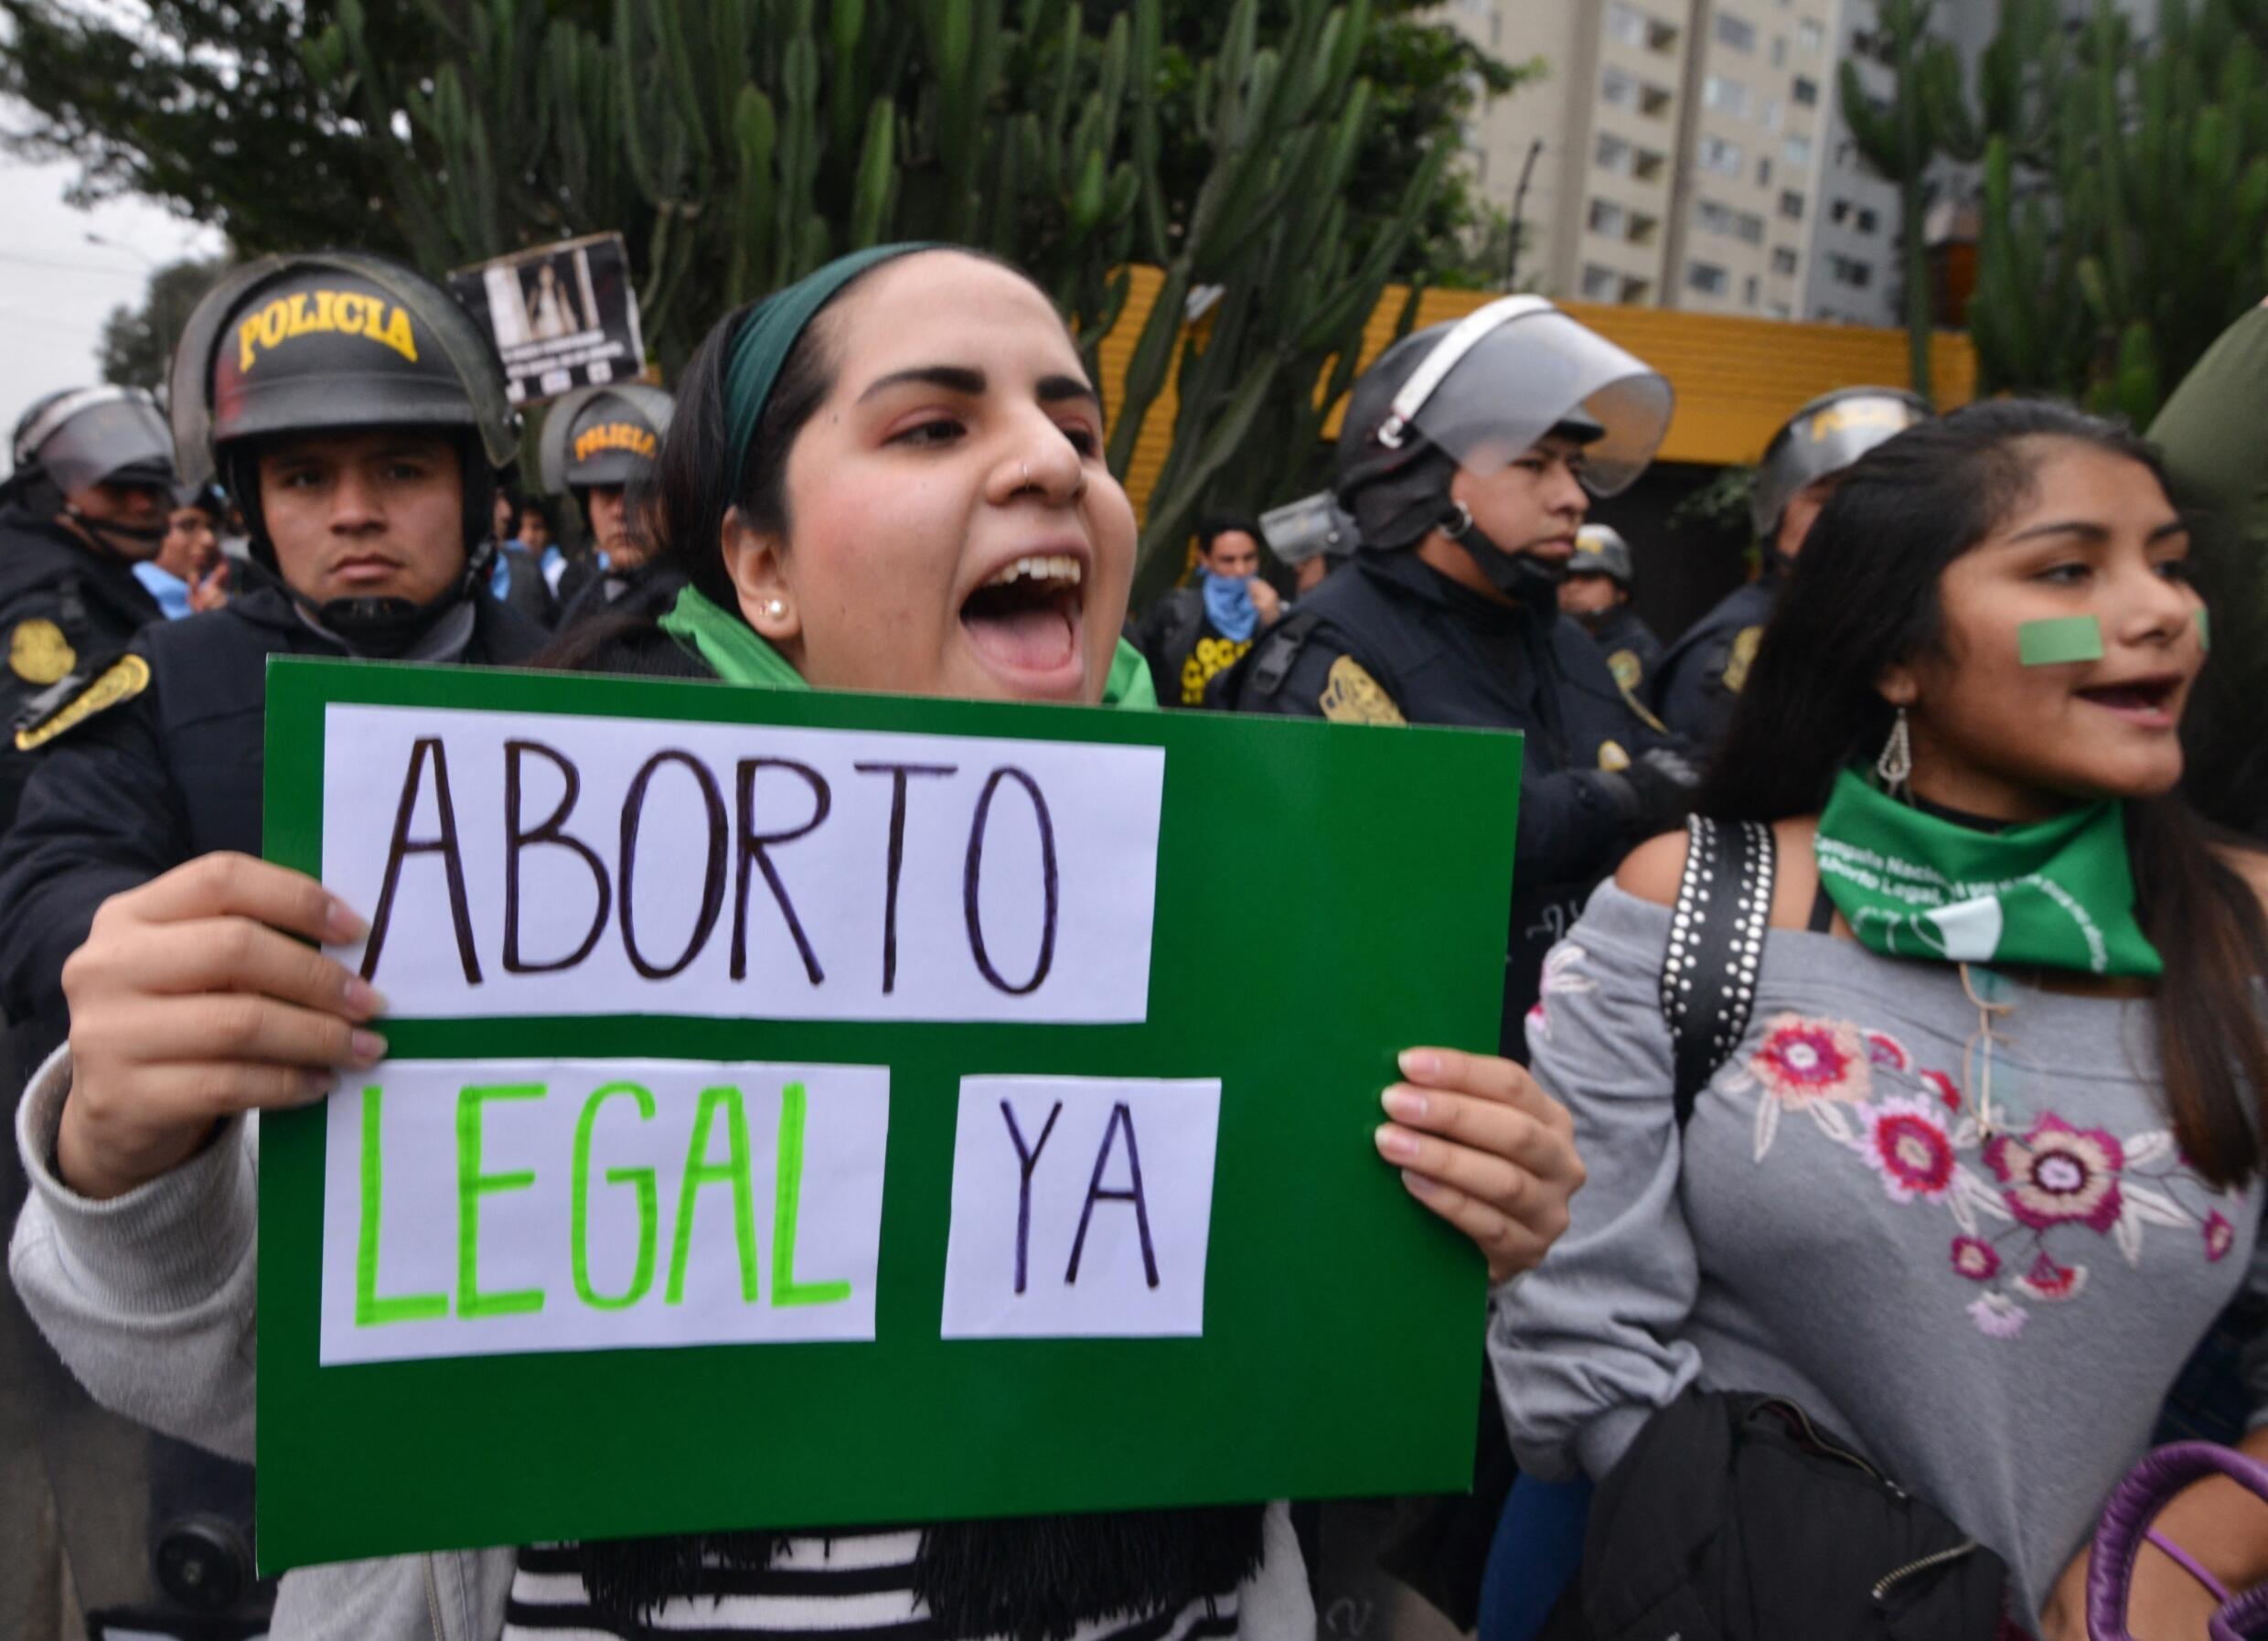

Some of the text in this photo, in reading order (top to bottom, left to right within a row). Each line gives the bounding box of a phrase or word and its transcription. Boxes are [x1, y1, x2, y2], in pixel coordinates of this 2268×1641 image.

[239, 290, 419, 374] POLICIA
[356, 736, 1059, 998] ABORTO
[356, 1082, 1160, 1327] LEGAL YA
